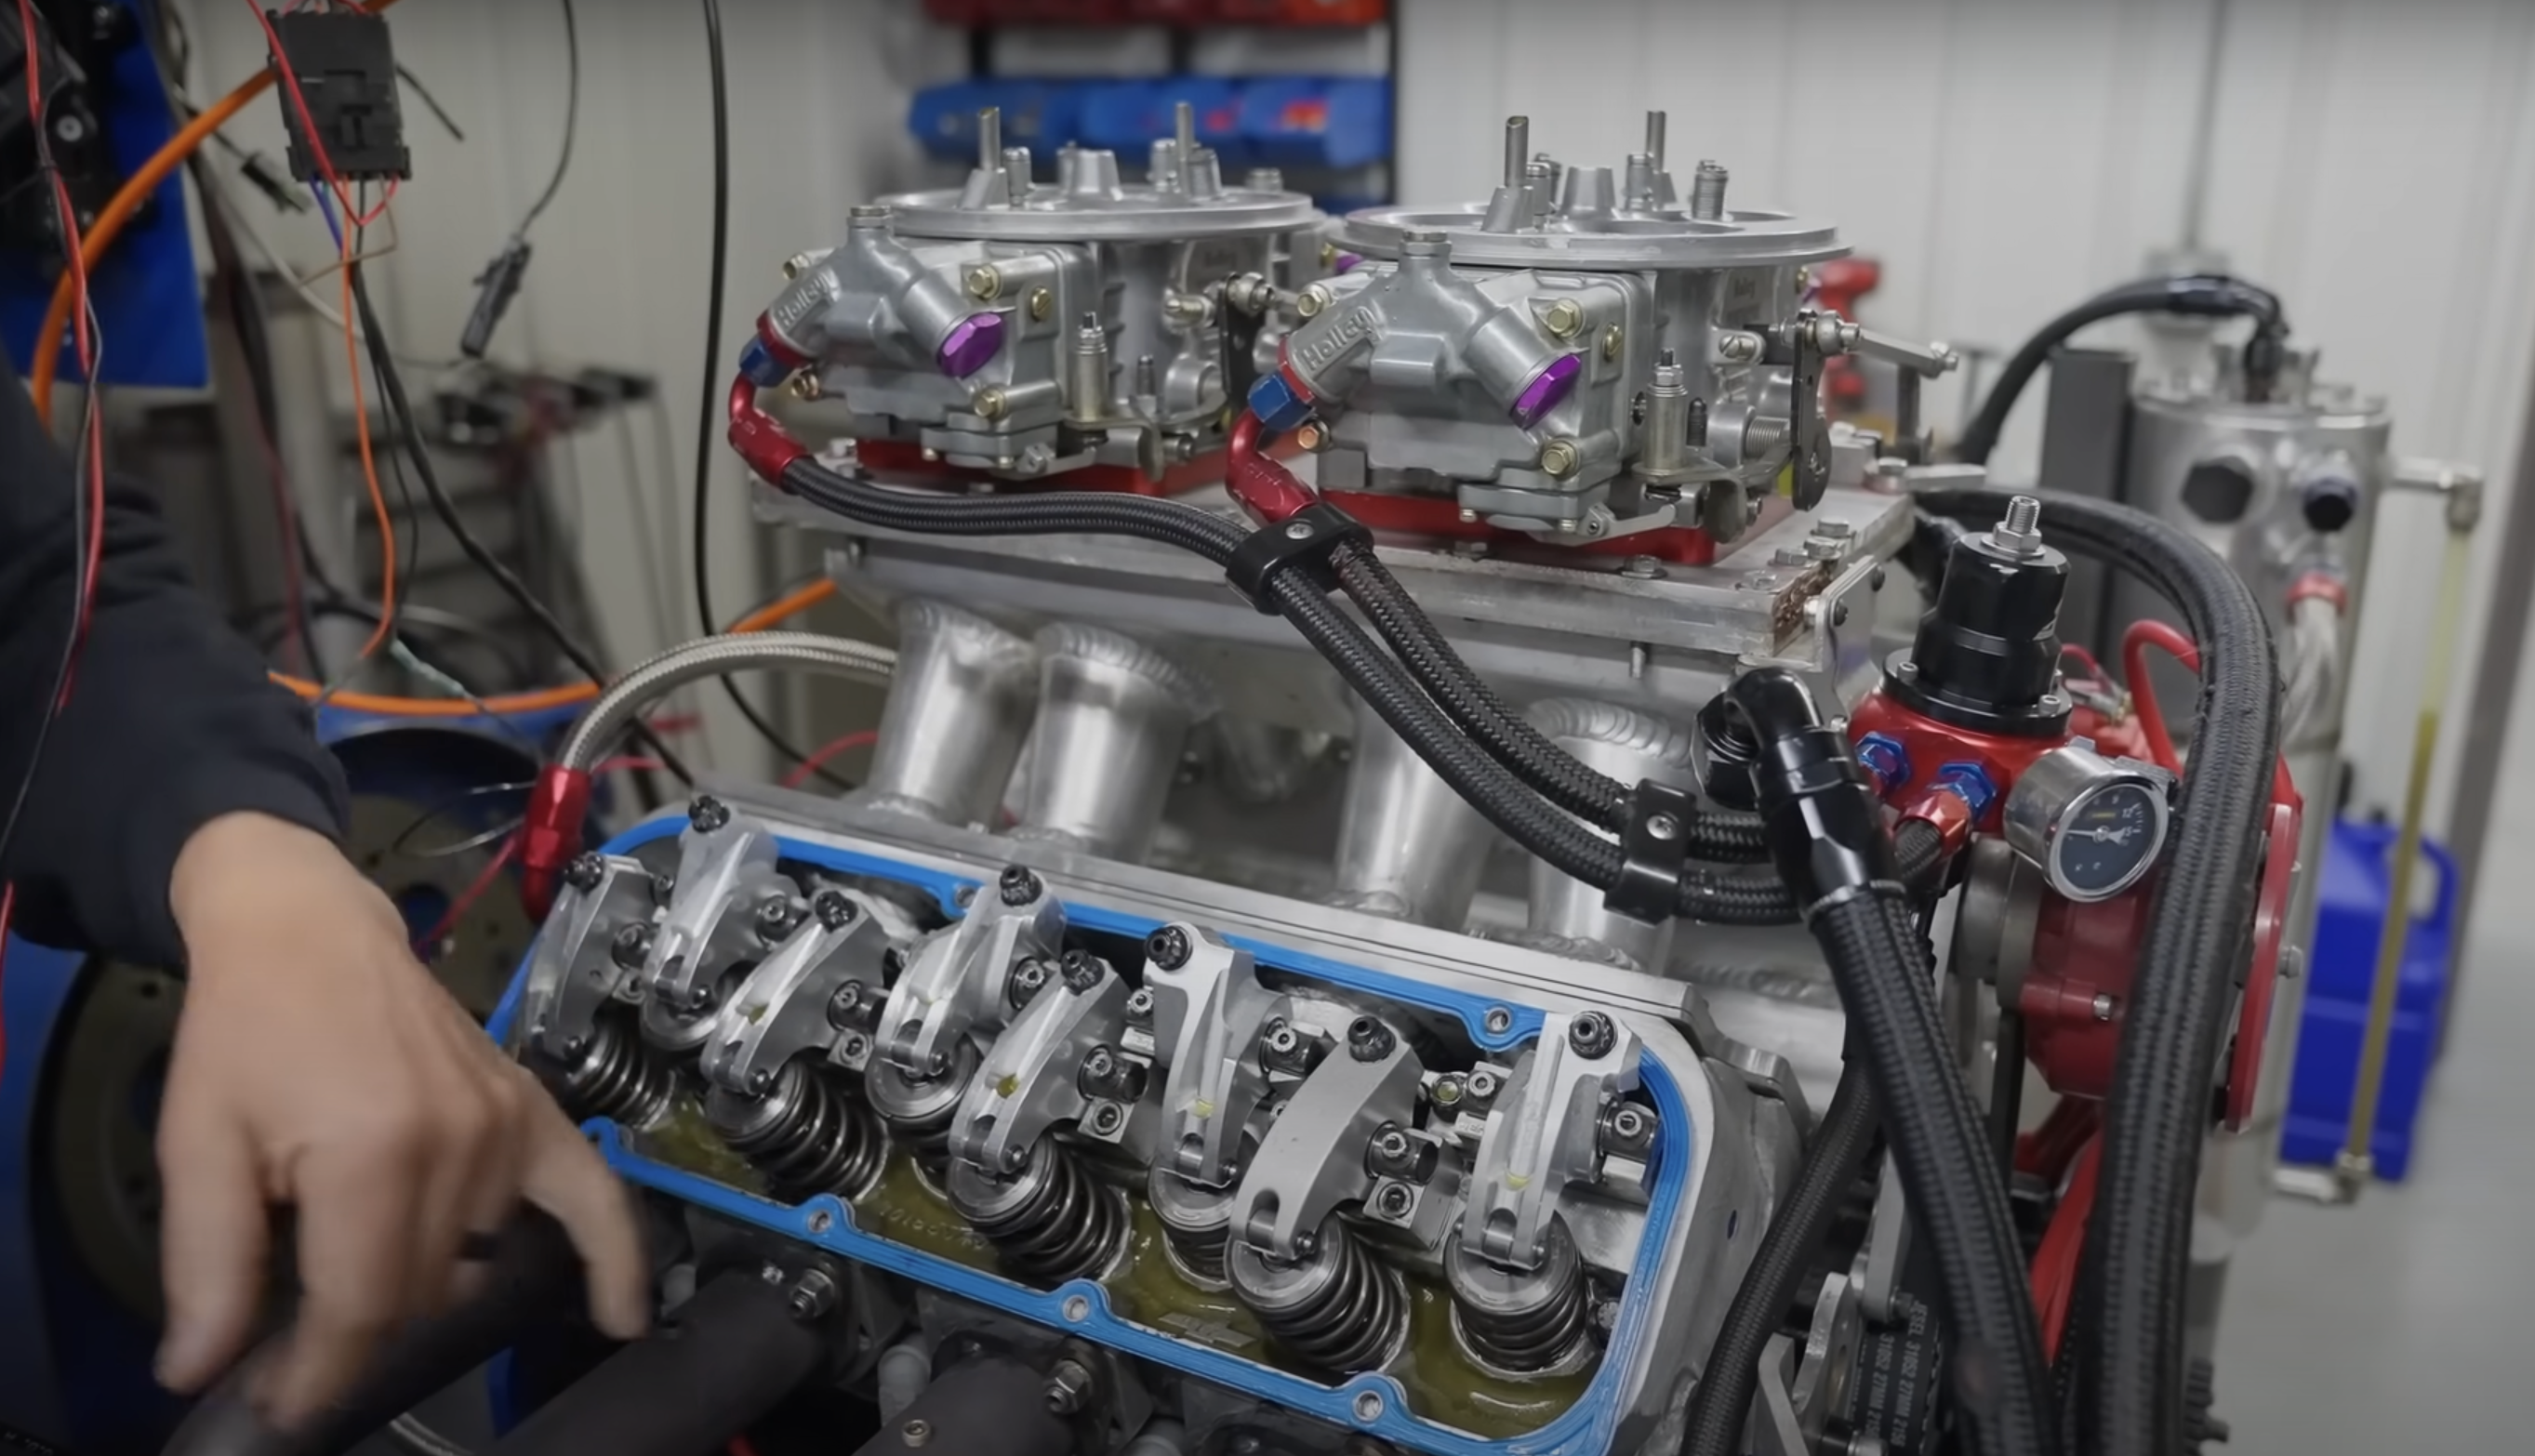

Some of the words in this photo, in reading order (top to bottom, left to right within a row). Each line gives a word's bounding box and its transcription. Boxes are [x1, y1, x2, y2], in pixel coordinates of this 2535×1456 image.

[777, 274, 830, 327] Holley
[1300, 306, 1374, 372] Holley
[1908, 1300, 1928, 1336] JESEL
[1868, 1371, 1888, 1410] 27MM
[1895, 1380, 1915, 1418] 27MM
